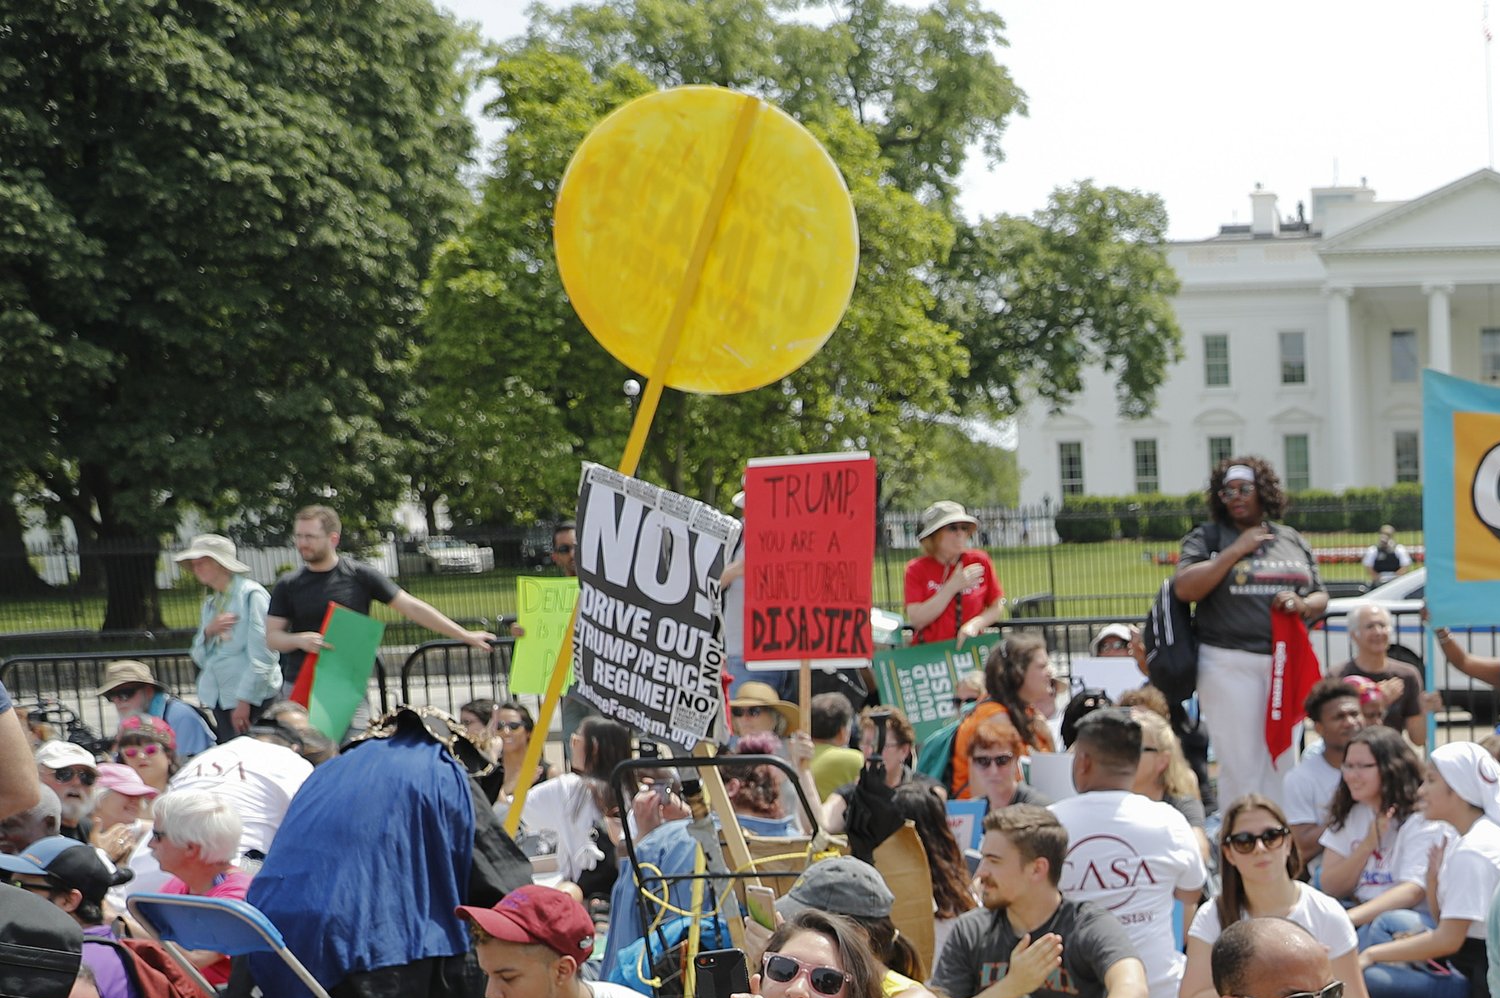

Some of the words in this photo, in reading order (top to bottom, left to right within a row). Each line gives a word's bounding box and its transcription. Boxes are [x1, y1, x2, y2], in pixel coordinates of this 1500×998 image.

[764, 468, 860, 520] TRUMP,
[580, 483, 722, 621] NO!
[758, 531, 786, 553] YOU
[790, 530, 816, 553] ARE
[827, 530, 841, 553] A
[753, 560, 869, 604] NATURAL
[581, 581, 652, 643] DRIVE
[656, 616, 711, 662] OUT
[752, 605, 869, 654] DISASTER
[580, 617, 712, 696] TRUMP/PENCE
[592, 658, 675, 714] REGIME!
[678, 691, 715, 715] NO!
[897, 668, 921, 724] RESIST
[912, 664, 937, 722] BUILD
[926, 660, 957, 719] RISE
